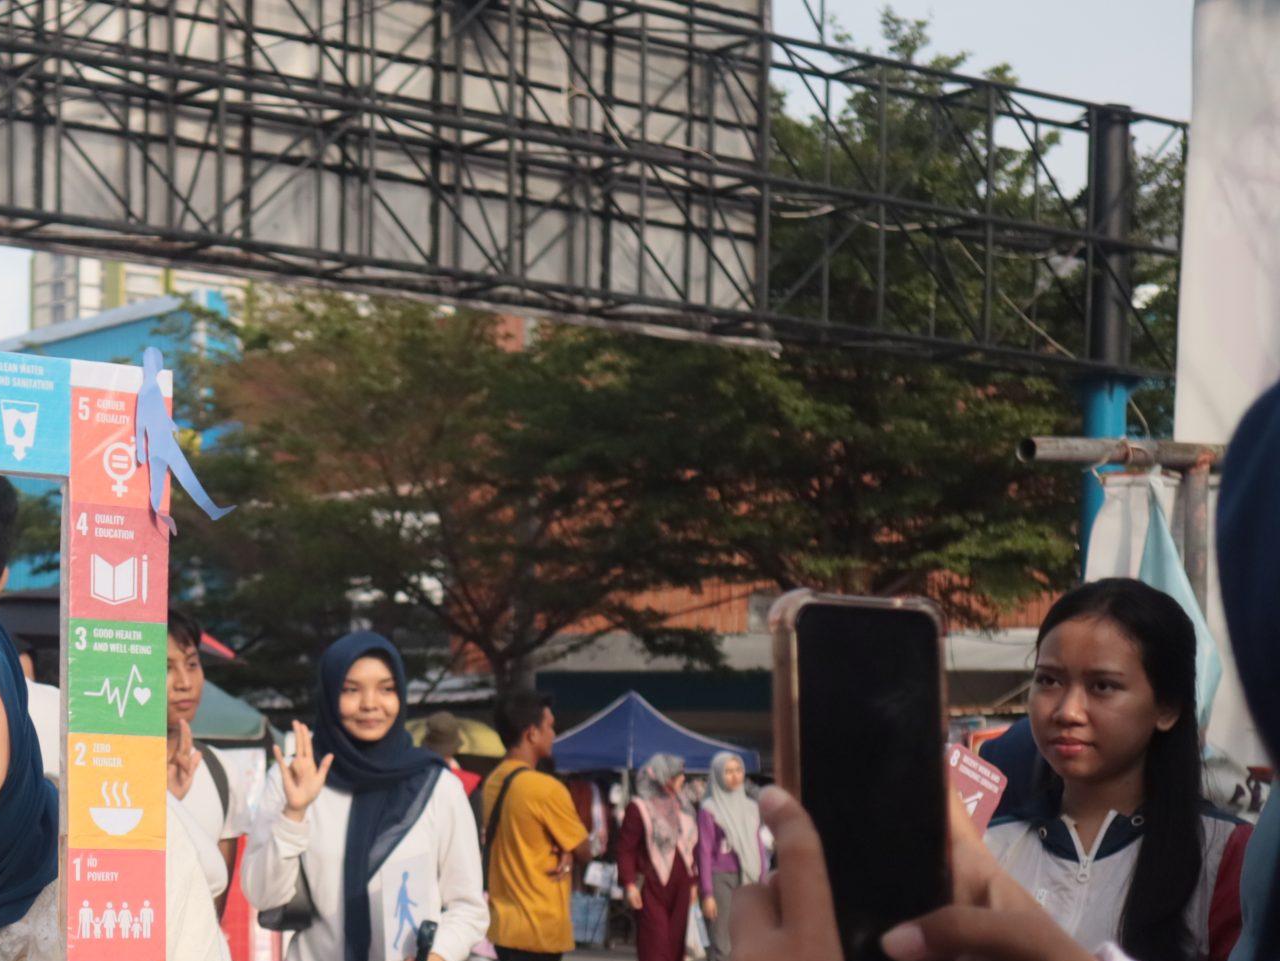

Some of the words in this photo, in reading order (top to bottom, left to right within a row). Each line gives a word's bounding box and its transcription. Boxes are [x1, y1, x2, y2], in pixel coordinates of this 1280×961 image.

[19, 364, 44, 376] WATER
[12, 377, 54, 391] SANITATION
[78, 396, 90, 421] 5
[96, 399, 126, 411] GENDER
[96, 413, 130, 426] EQUALITY
[76, 512, 88, 536] 4
[95, 513, 125, 525] QUALITY
[94, 527, 135, 540] EDUCATION
[75, 626, 87, 650] 3
[93, 628, 114, 639] GOOD
[115, 629, 142, 641] HEALTH
[93, 642, 109, 653] AND
[110, 643, 152, 655] WELL-BEING
[74, 742, 87, 766] 2
[93, 743, 111, 753] ZERO
[92, 757, 123, 768] HUNGER
[950, 749, 960, 767] 8
[73, 856, 81, 881] 1
[87, 857, 98, 868] NO
[87, 871, 119, 882] POVERTY
